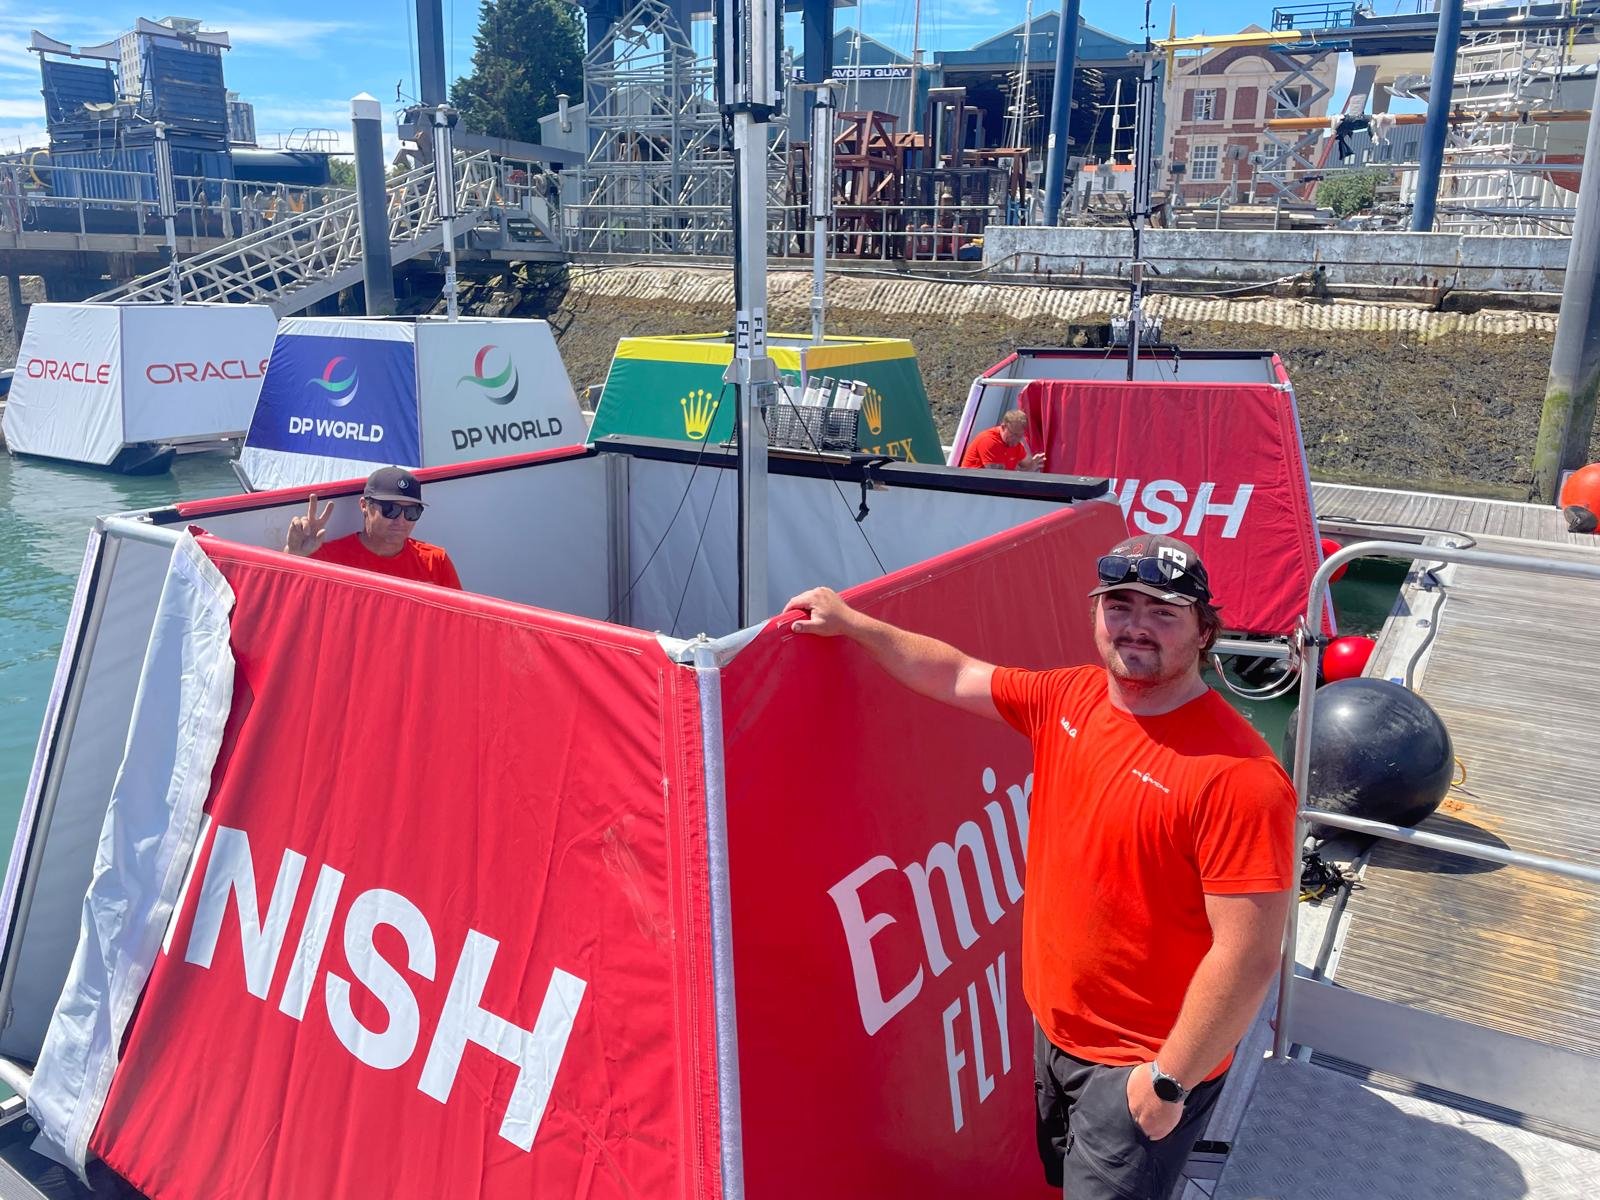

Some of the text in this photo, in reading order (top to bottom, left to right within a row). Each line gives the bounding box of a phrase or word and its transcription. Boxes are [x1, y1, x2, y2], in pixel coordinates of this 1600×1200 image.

[799, 68, 908, 77] EAVOUR QUAY
[738, 320, 749, 349] FL1
[754, 317, 762, 345] FL1
[27, 358, 111, 385] ORACLE
[288, 416, 384, 443] DP WORLD
[452, 417, 563, 450] DP WORLD
[1109, 477, 1255, 539] ISH
[826, 766, 1034, 1037] Emir
[942, 951, 1011, 1133] FLY
